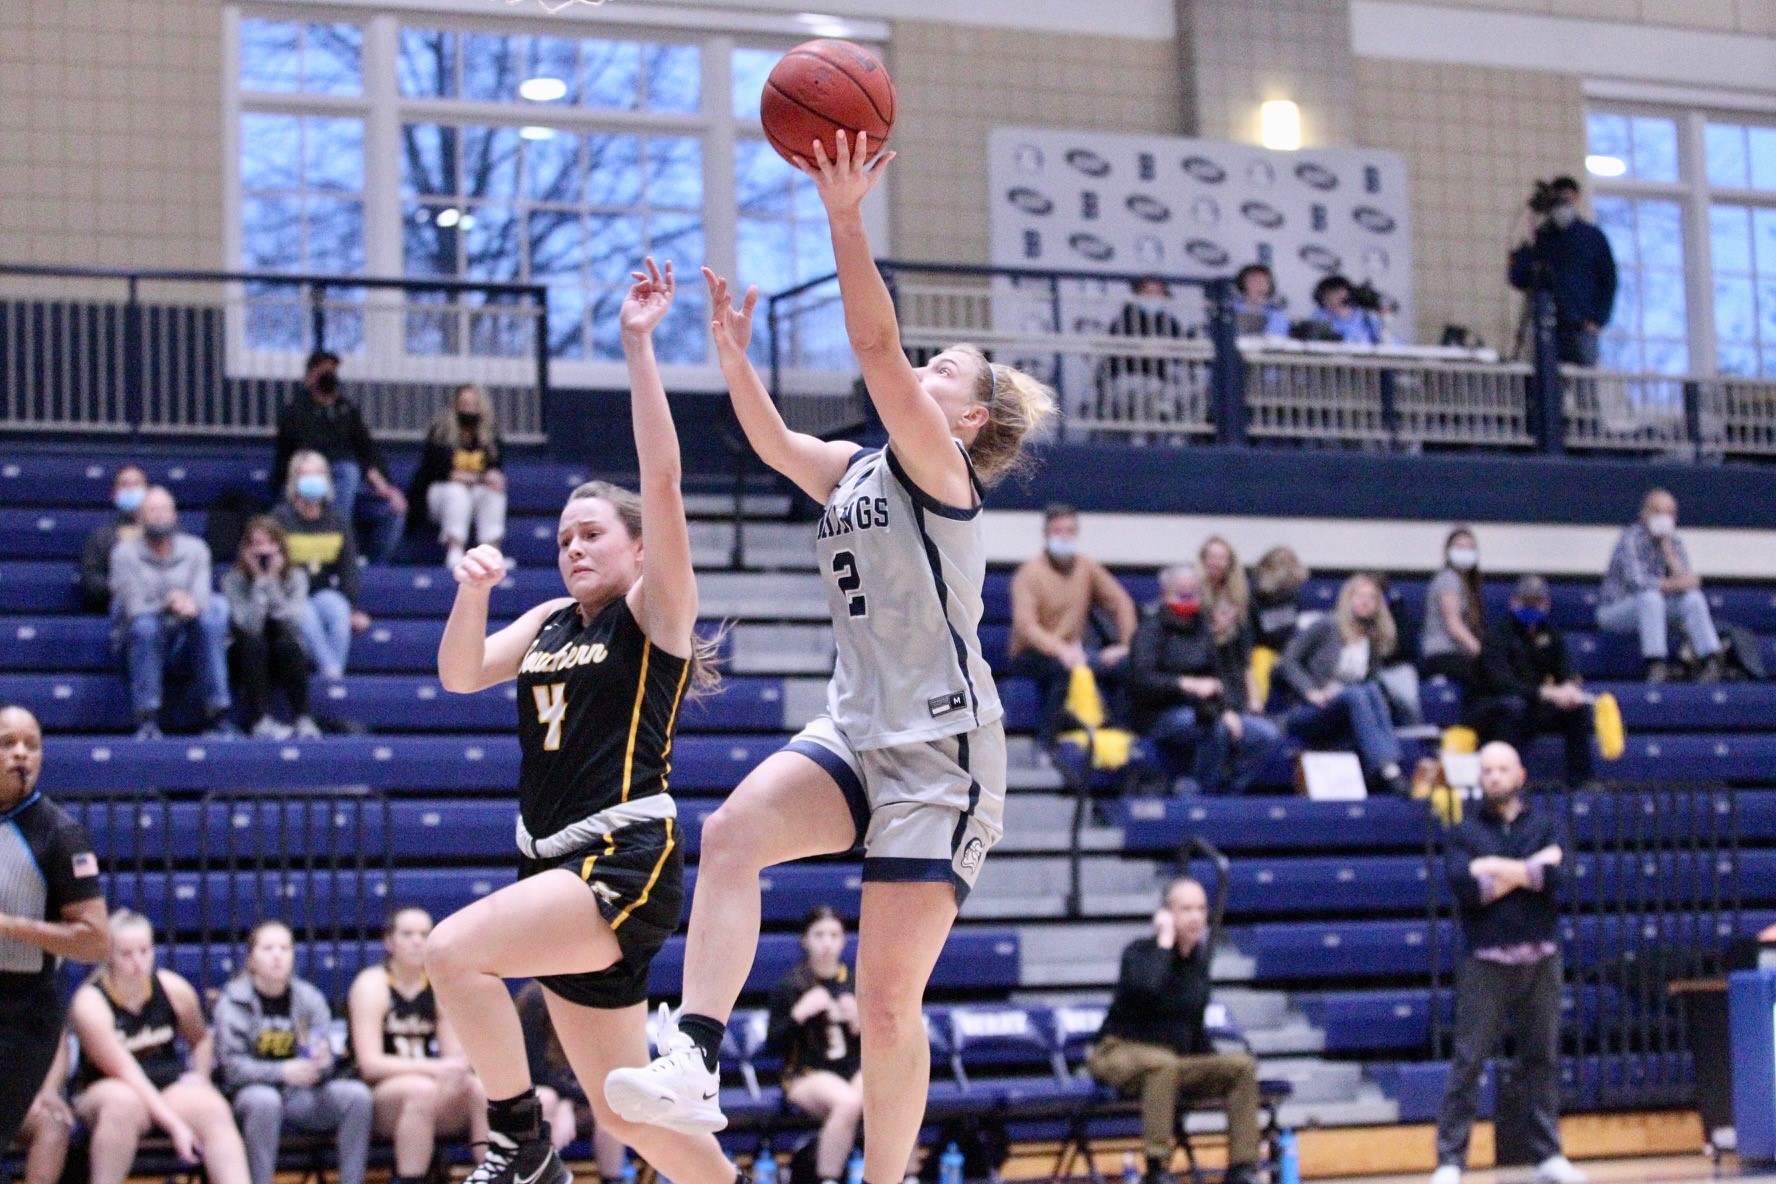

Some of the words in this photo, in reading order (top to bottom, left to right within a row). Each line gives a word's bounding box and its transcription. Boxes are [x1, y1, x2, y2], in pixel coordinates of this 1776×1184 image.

[831, 549, 867, 617] 2
[532, 682, 568, 751] 4
[953, 696, 962, 705] M
